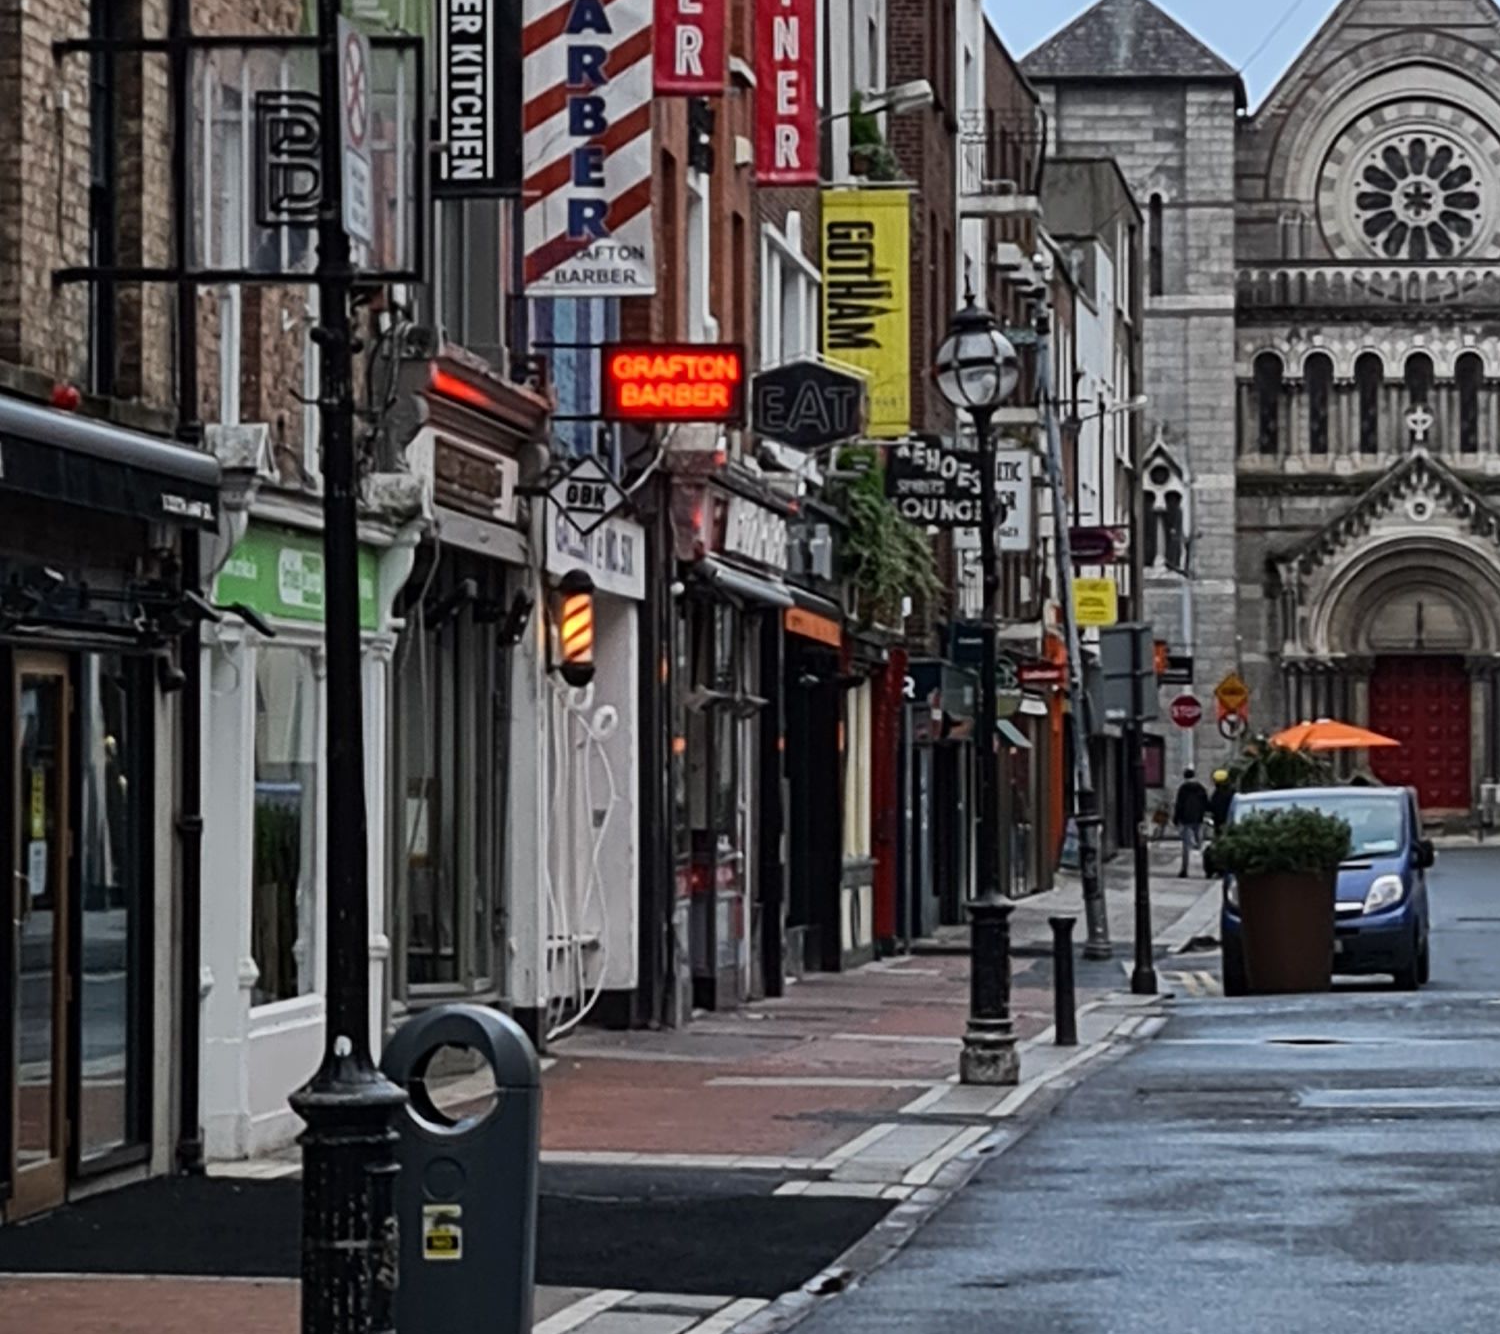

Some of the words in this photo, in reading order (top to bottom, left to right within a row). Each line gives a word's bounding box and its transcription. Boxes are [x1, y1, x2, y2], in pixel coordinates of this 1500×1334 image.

[451, 44, 483, 181] KITCHEN
[554, 268, 637, 284] BARBER
[826, 221, 900, 350] GOTHAM
[612, 354, 738, 380] GRAFTON
[620, 383, 729, 407] BARBER
[758, 380, 856, 432] EAT
[566, 484, 606, 508] GBK
